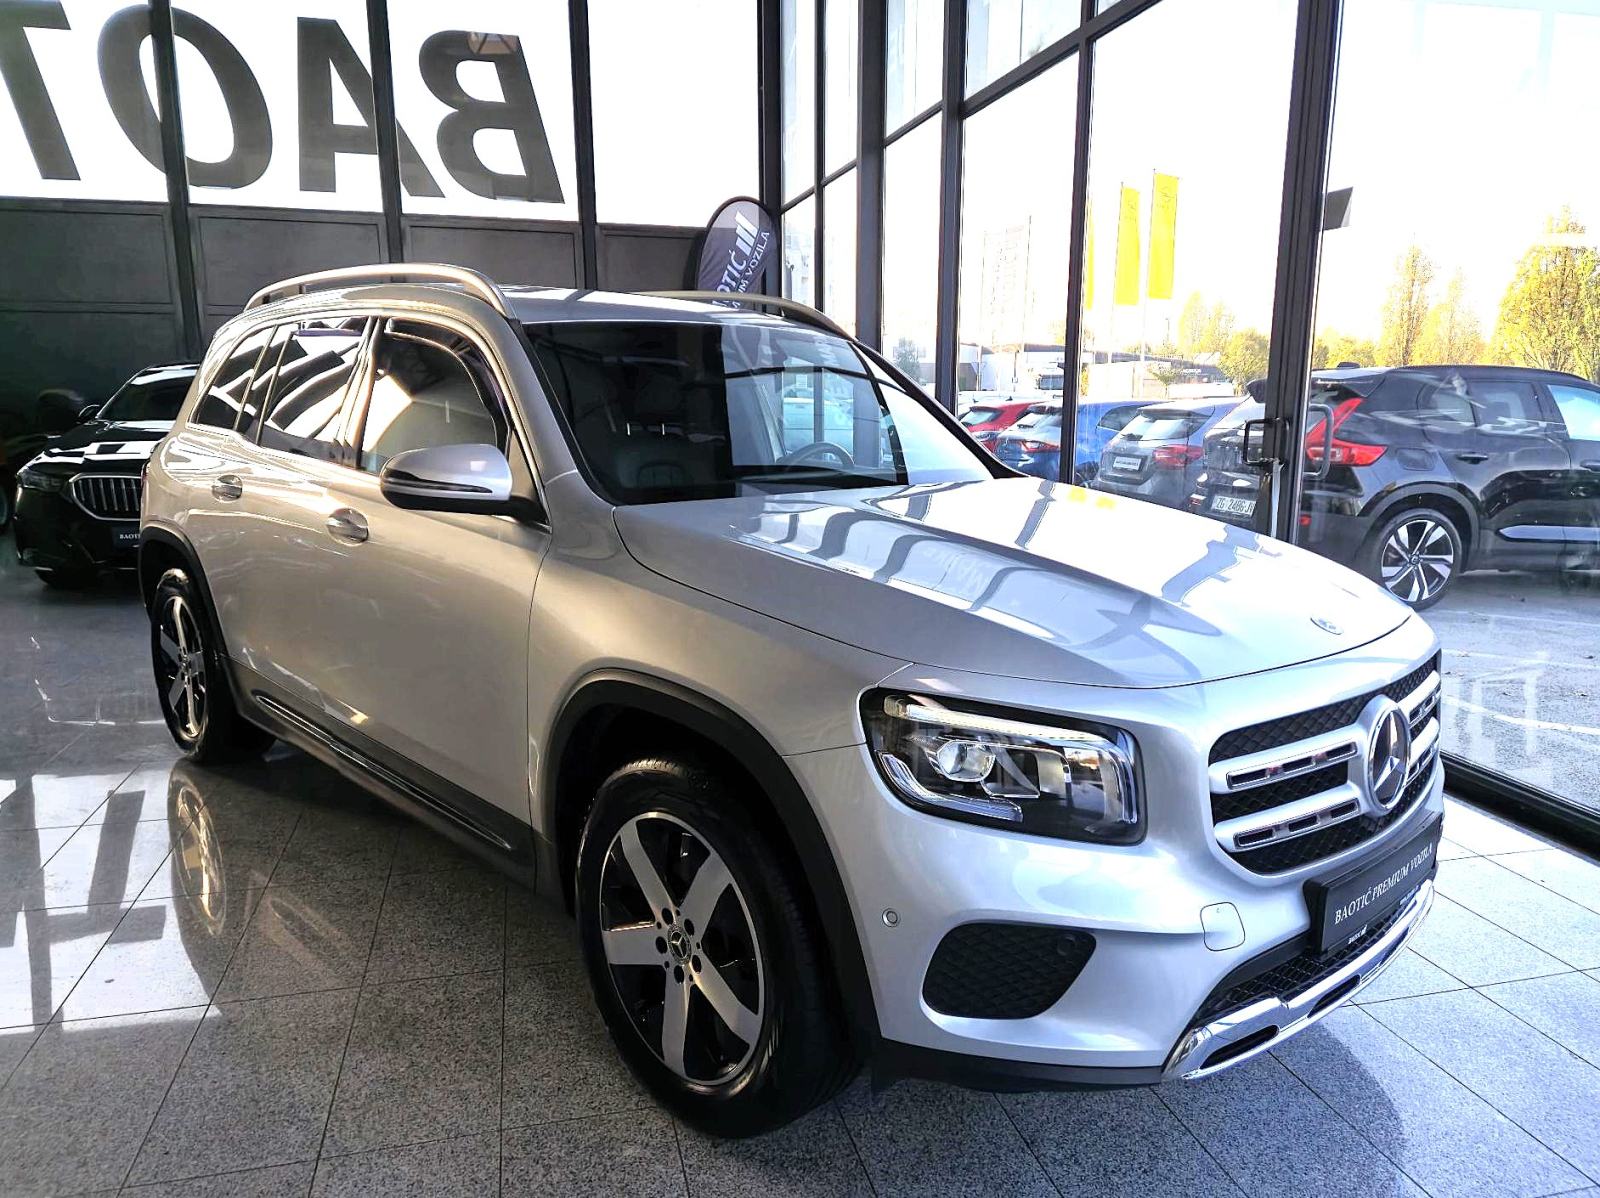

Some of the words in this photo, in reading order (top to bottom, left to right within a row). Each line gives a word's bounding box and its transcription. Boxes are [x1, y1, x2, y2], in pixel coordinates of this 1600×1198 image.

[712, 249, 746, 307] OTIĆ
[745, 231, 770, 275] VOZILA
[1334, 886, 1372, 925] BAOTIĆ
[1372, 863, 1410, 900] PREMIUM
